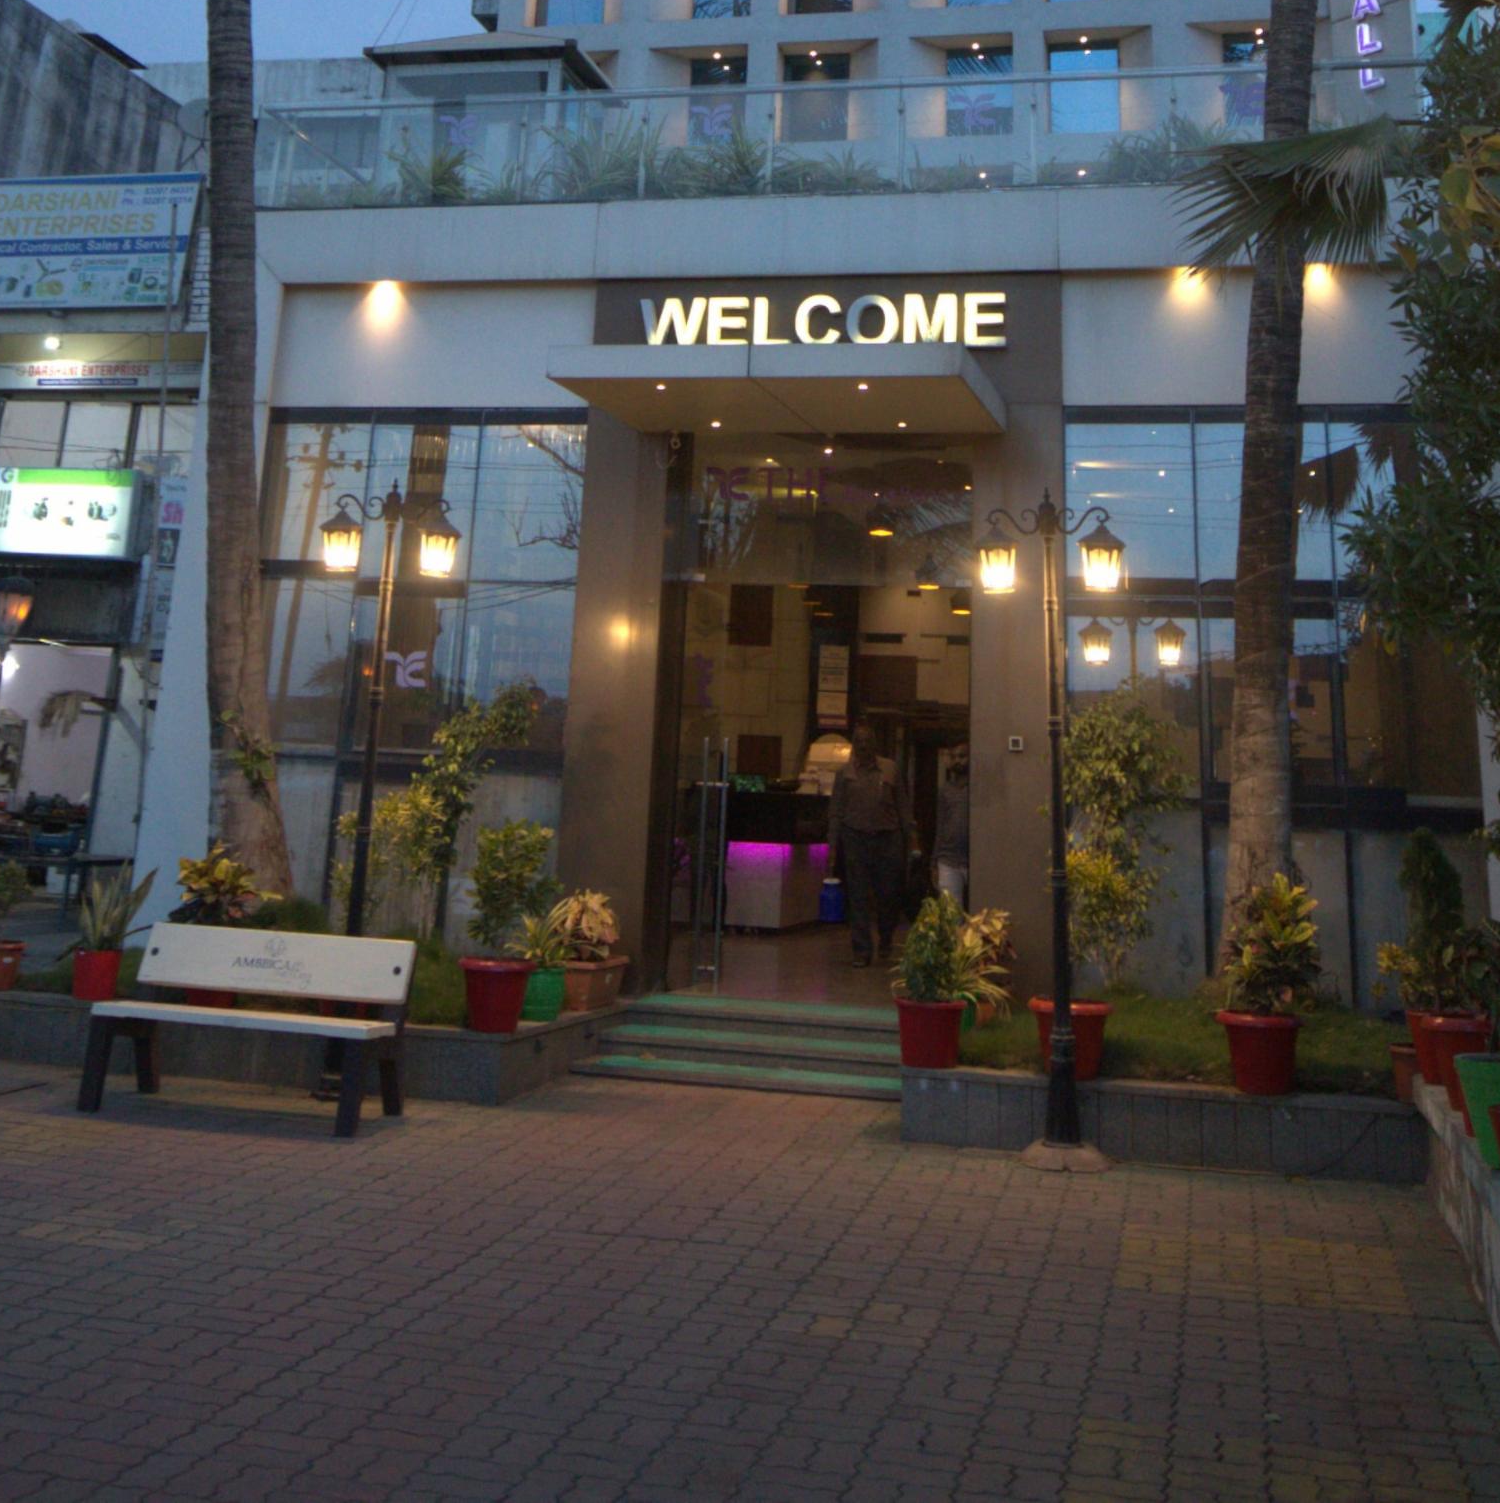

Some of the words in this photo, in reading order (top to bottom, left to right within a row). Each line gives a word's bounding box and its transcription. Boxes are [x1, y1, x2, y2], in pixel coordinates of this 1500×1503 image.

[85, 239, 119, 252] Sales
[121, 239, 132, 251] &
[640, 292, 1006, 347] WELCOME
[81, 364, 150, 377] ENTERPRISES
